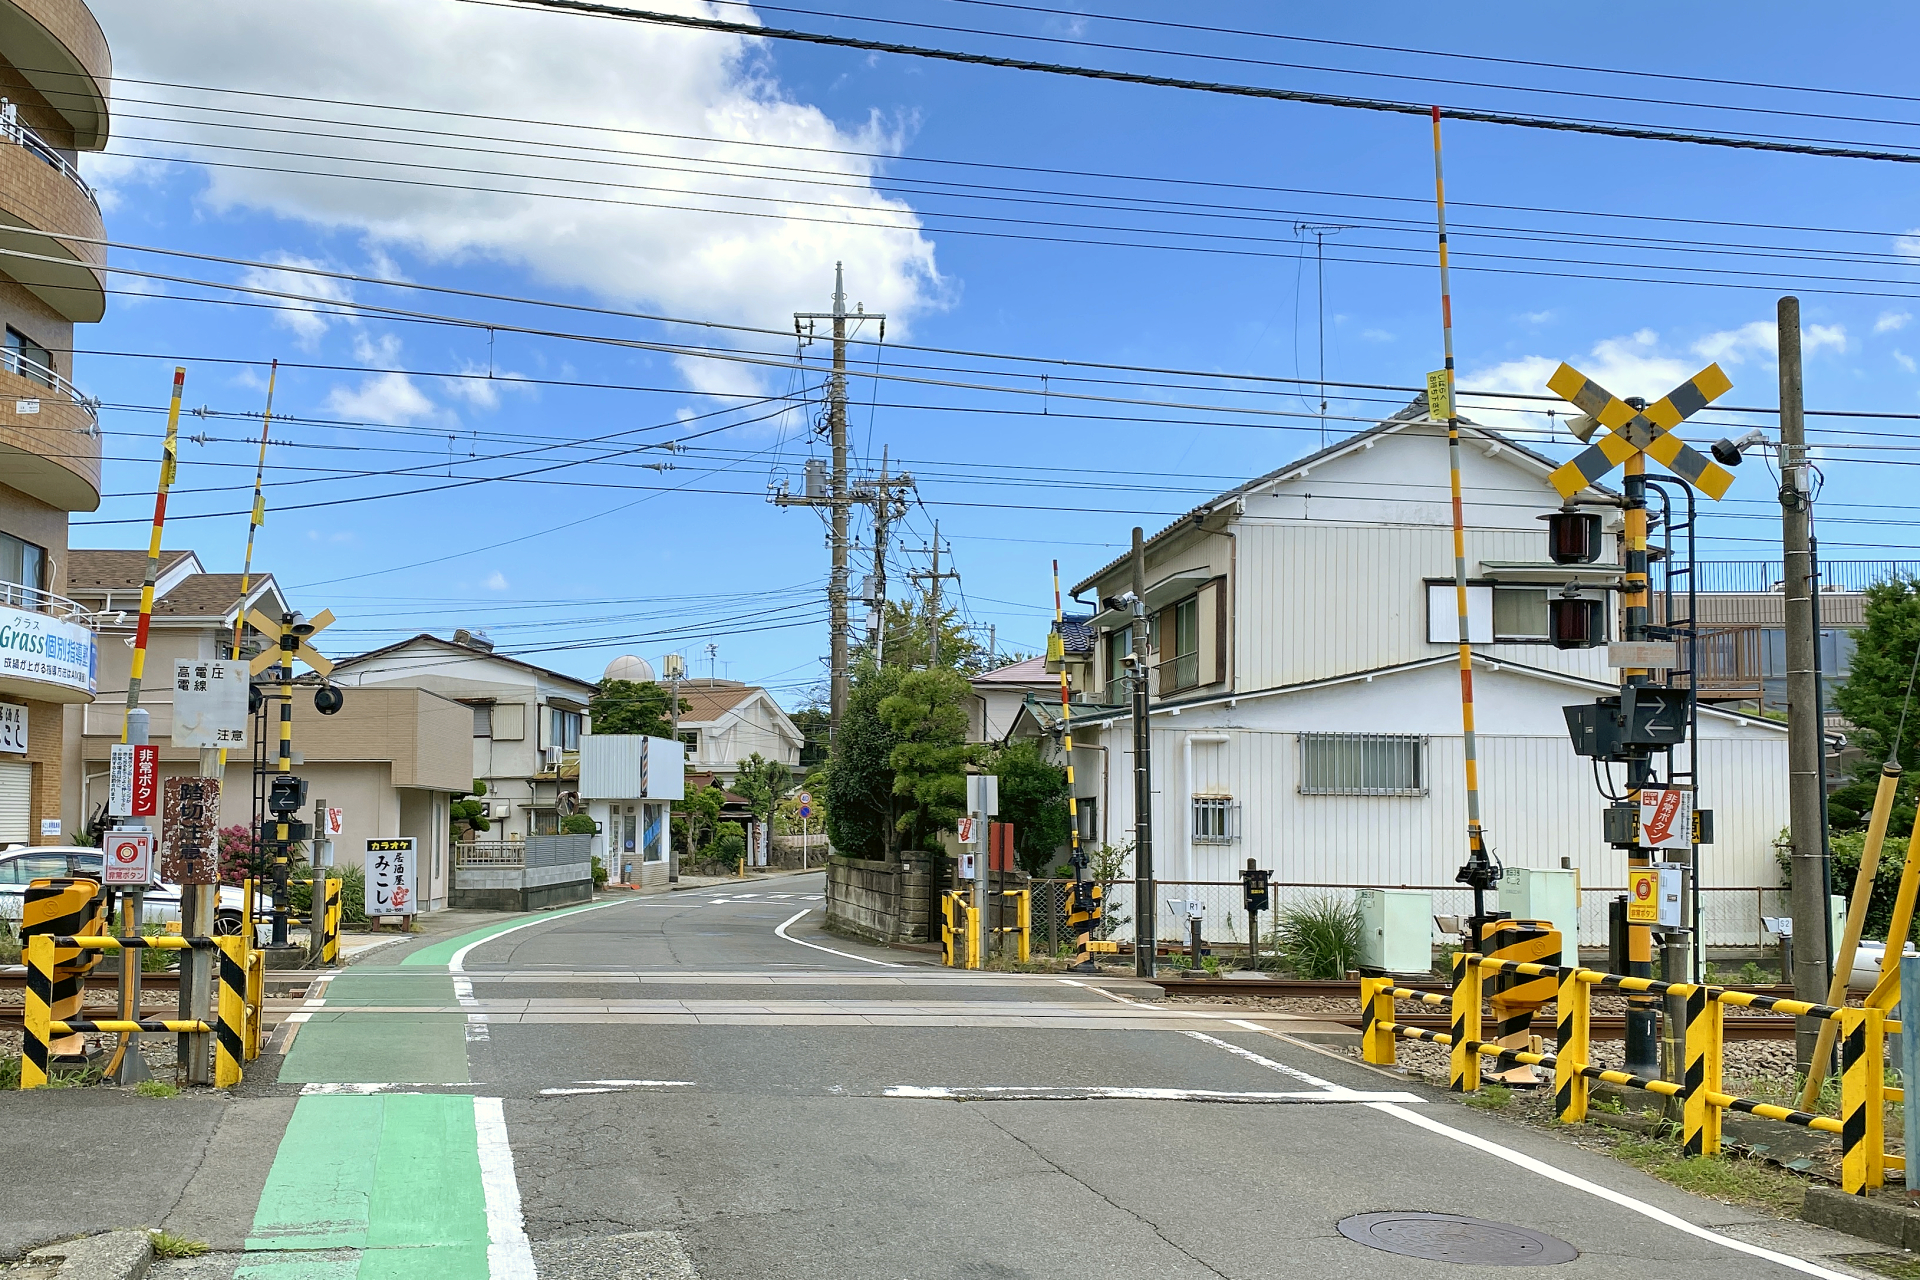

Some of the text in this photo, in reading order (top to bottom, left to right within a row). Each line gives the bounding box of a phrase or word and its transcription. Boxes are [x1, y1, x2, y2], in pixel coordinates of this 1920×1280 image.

[1438, 374, 1447, 400] しばらく
[14, 616, 40, 630] グラス
[0, 625, 44, 654] Grass
[178, 666, 224, 679] 高電圧
[178, 679, 207, 691] 電線
[0, 724, 25, 748] こし
[217, 729, 243, 741] 注意
[138, 749, 154, 812] 非常ボタン
[1650, 793, 1678, 838] 非常ボタン
[371, 841, 408, 850] カラオケ
[109, 871, 143, 879] 非常ボタン
[393, 852, 404, 885] 居酒屋
[375, 855, 390, 904] みこし
[1190, 902, 1198, 910] R1
[1780, 919, 1790, 927] S2
